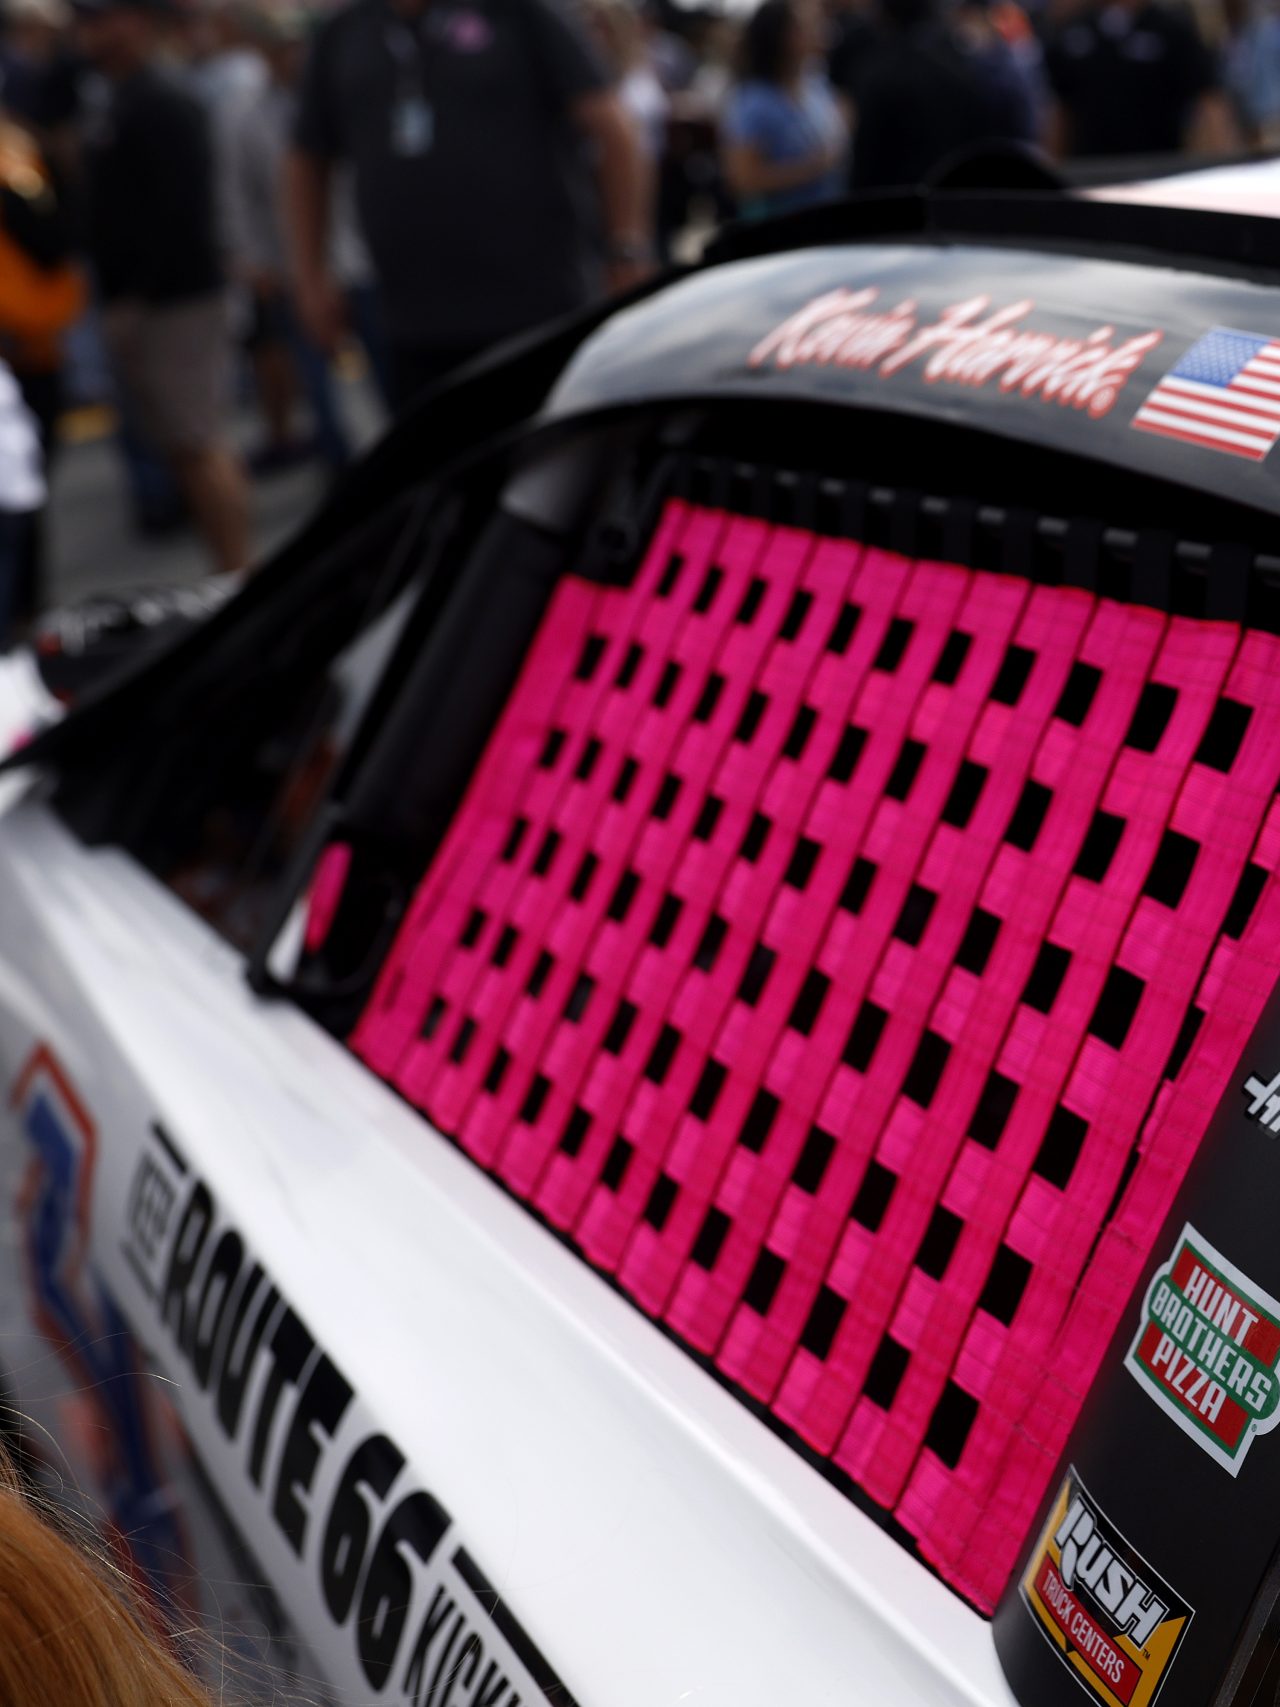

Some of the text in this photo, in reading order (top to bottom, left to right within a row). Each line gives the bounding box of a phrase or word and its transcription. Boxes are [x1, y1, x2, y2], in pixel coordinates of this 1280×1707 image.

[749, 287, 1162, 412] Kevin Harvick
[1149, 1285, 1273, 1412] BROTHERS
[1183, 1265, 1260, 1346] HUNT
[162, 1179, 453, 1693] ROUTE 66
[1151, 1333, 1228, 1424] PIZZA
[1042, 1569, 1125, 1684] TRUCK CENTERS
[1054, 1497, 1169, 1648] RUSH
[404, 1583, 522, 1707] KIC
